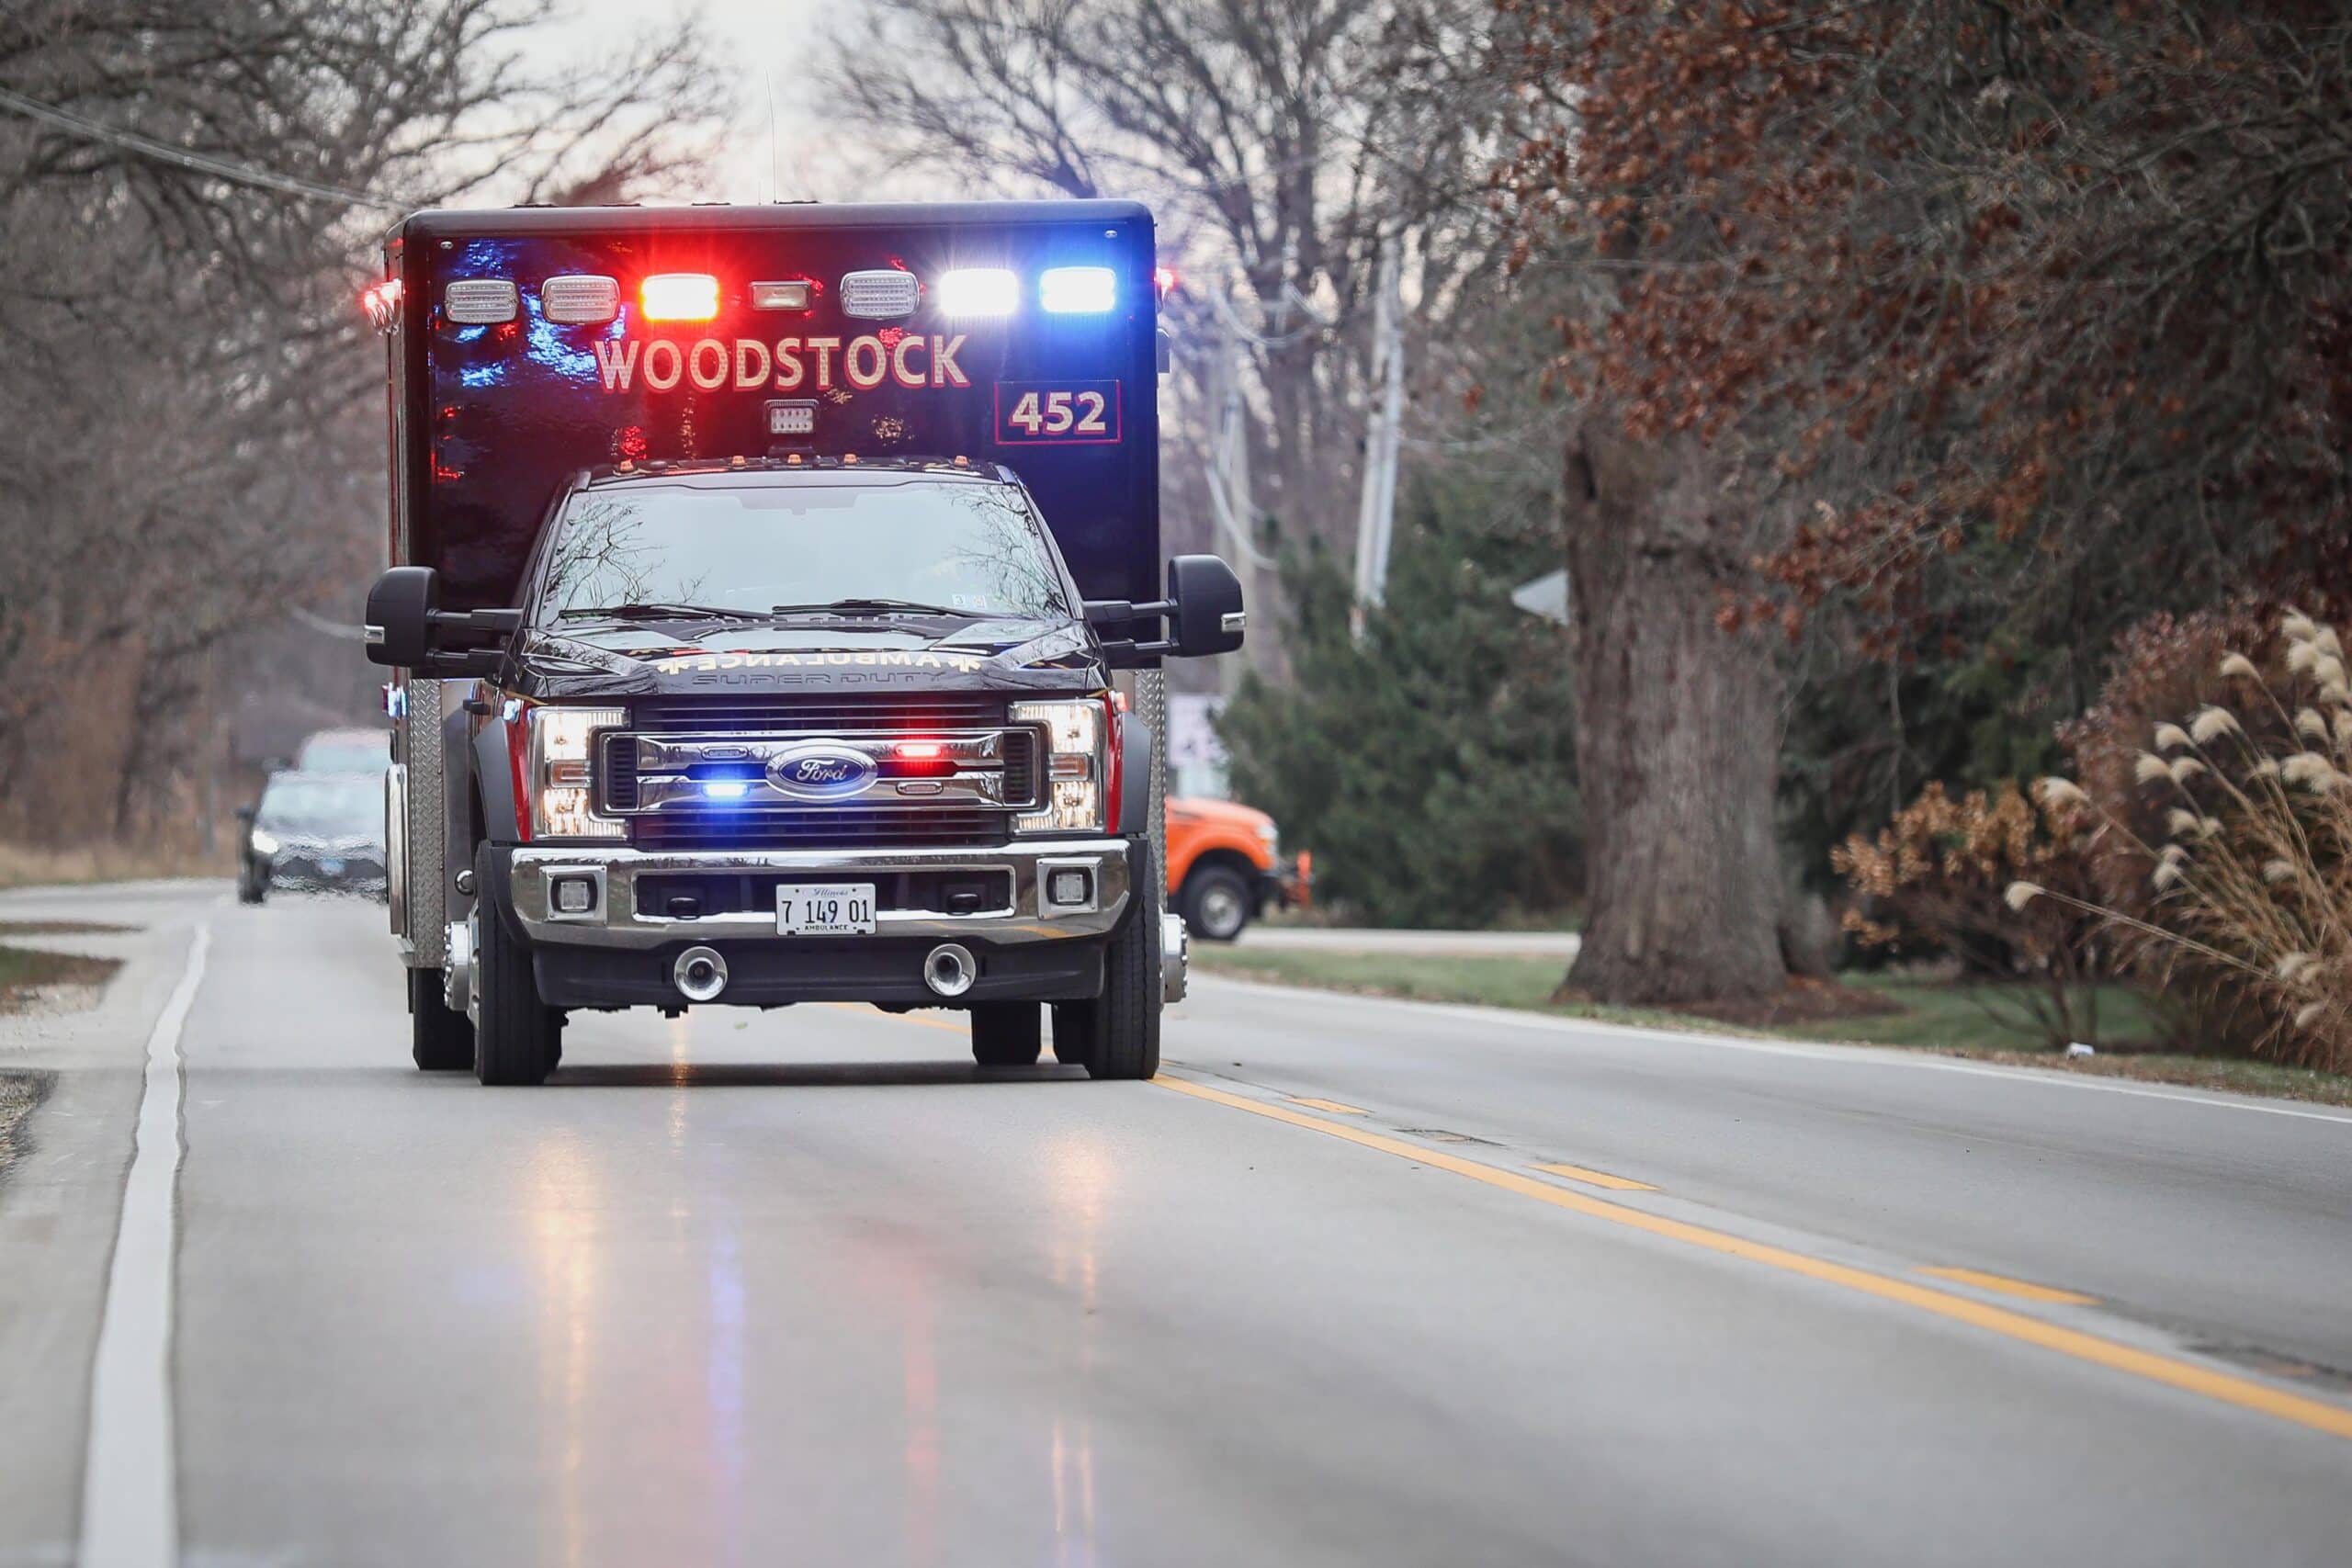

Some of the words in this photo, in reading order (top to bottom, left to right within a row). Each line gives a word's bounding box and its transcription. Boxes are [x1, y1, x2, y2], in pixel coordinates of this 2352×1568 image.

[594, 333, 971, 393] WOODSTOCK
[1009, 390, 1107, 435] 452
[691, 673, 831, 685] SUPER
[840, 671, 946, 683] DUTY
[796, 759, 849, 781] Ford
[811, 888, 848, 897] Illinois
[781, 900, 792, 924] 7
[804, 900, 838, 924] 149
[848, 899, 871, 923] 01
